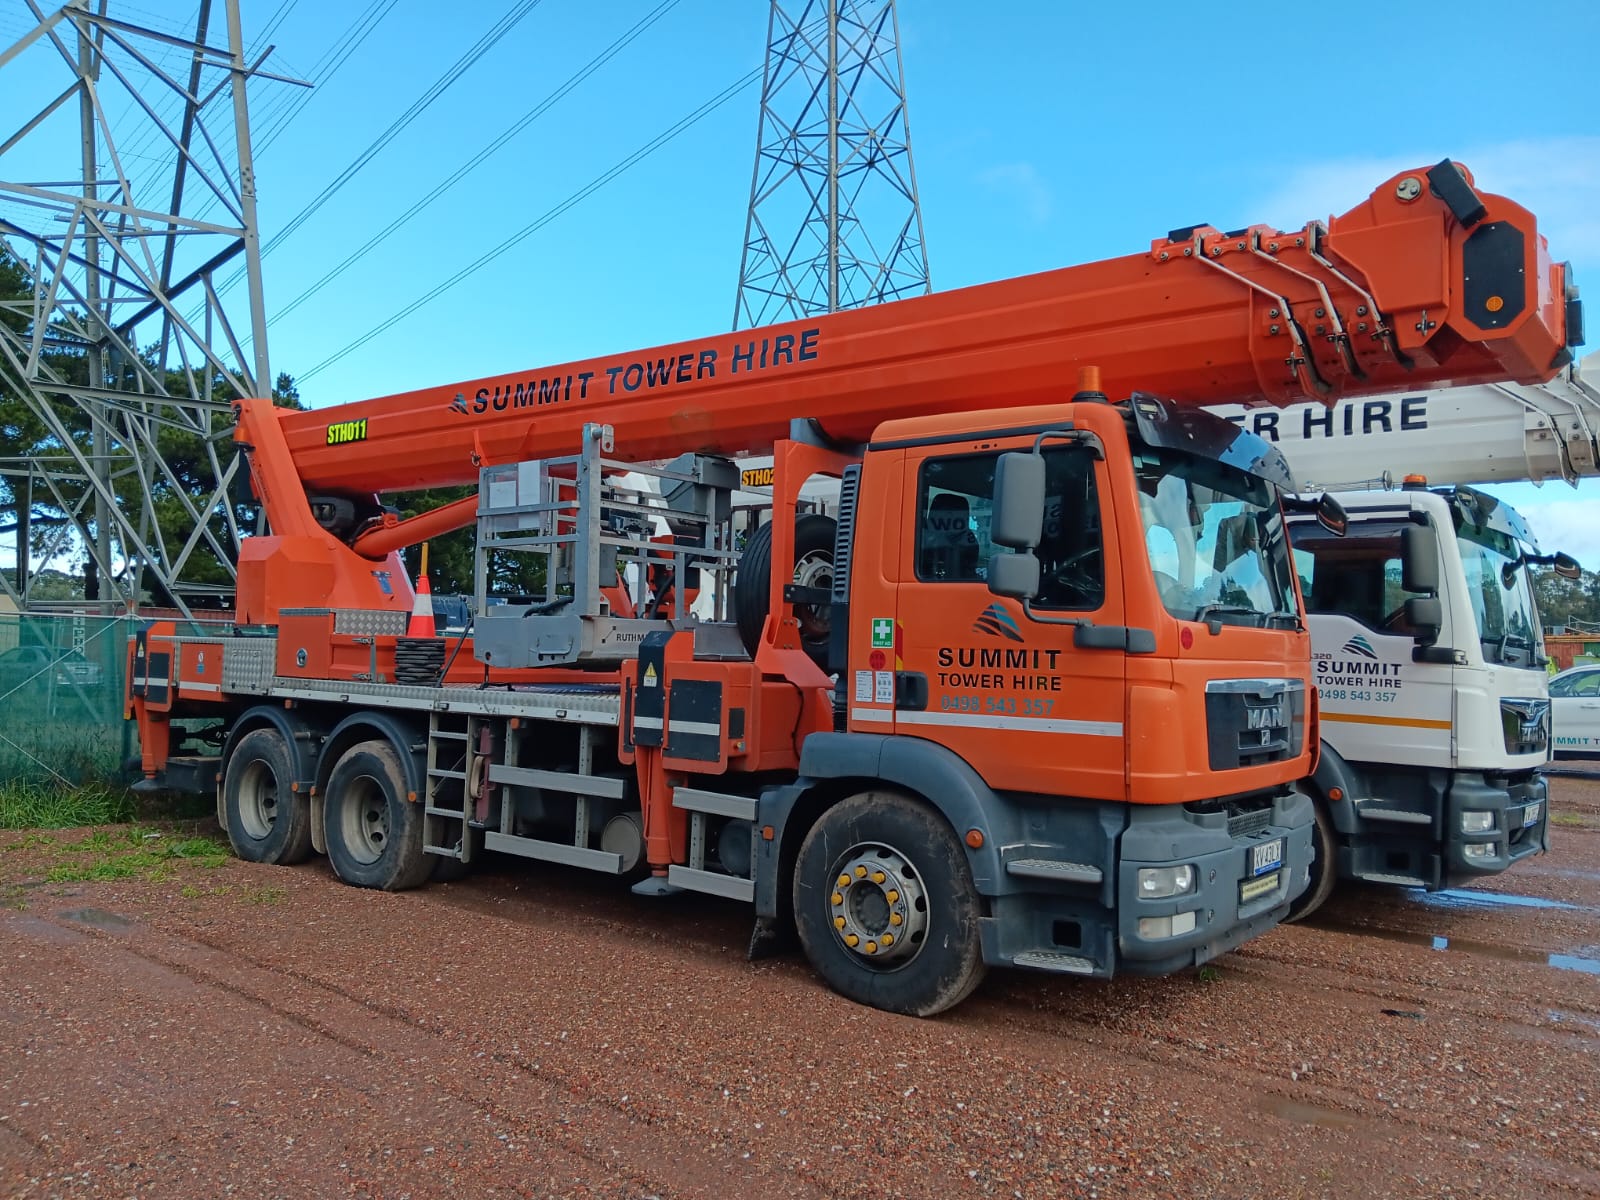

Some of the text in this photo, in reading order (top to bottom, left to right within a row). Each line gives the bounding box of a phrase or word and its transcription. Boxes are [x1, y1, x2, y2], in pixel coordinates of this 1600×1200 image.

[474, 328, 820, 413] SUMMIT TOWER HIRE
[1224, 396, 1428, 442] R HIRE
[328, 419, 367, 444] STH011
[616, 633, 646, 641] RUTHM
[938, 647, 1062, 670] SUMMIT
[1317, 660, 1402, 676] SUMMIT
[938, 673, 1062, 692] TOWER HIRE
[1317, 676, 1402, 688] TOWER HIRE
[941, 695, 1055, 715] 0498 543 357
[1318, 689, 1397, 703] 0498 543 357
[1247, 708, 1283, 729] MAN
[1553, 737, 1589, 745] MMIT
